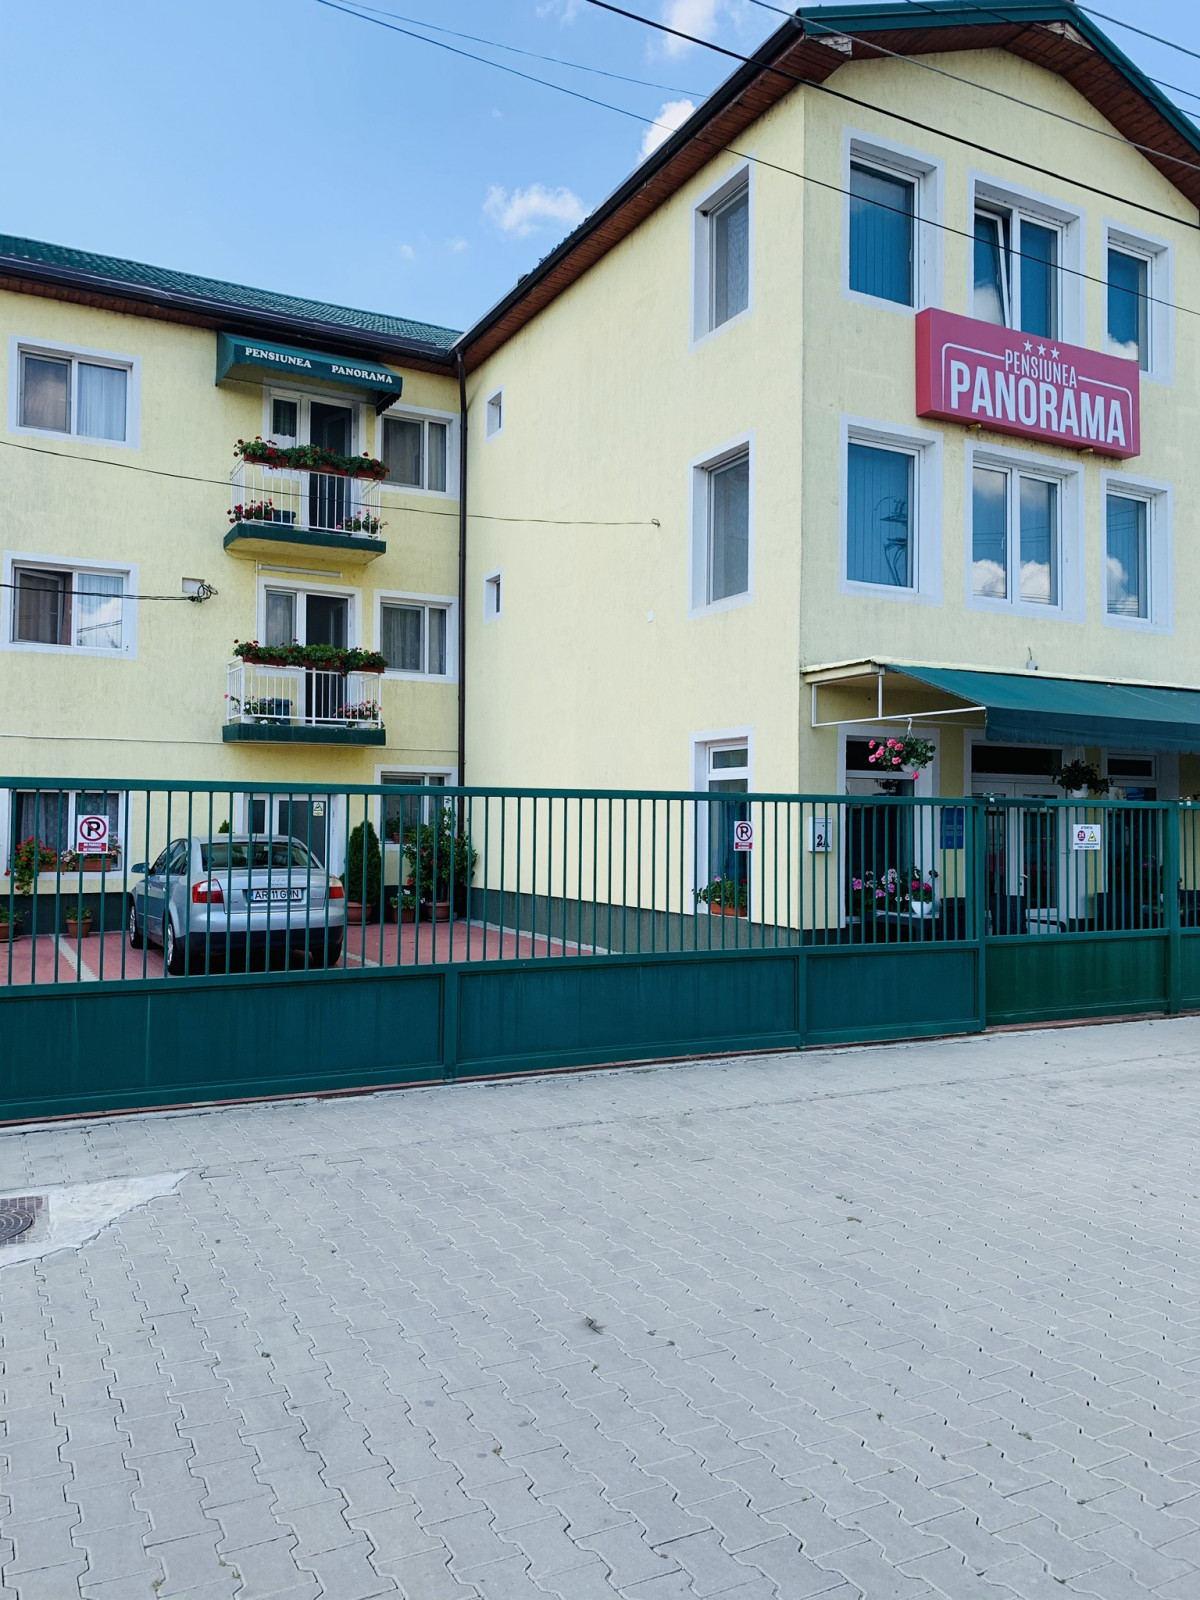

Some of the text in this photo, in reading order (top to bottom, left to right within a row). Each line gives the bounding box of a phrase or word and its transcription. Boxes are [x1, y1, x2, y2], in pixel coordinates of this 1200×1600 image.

[245, 347, 393, 384] PENSIUNEA PANORAMA
[1005, 349, 1077, 389] PENSIUNEA
[950, 359, 1126, 447] PANORAMA
[87, 821, 100, 836] P
[254, 889, 299, 900] AR 11 GN
